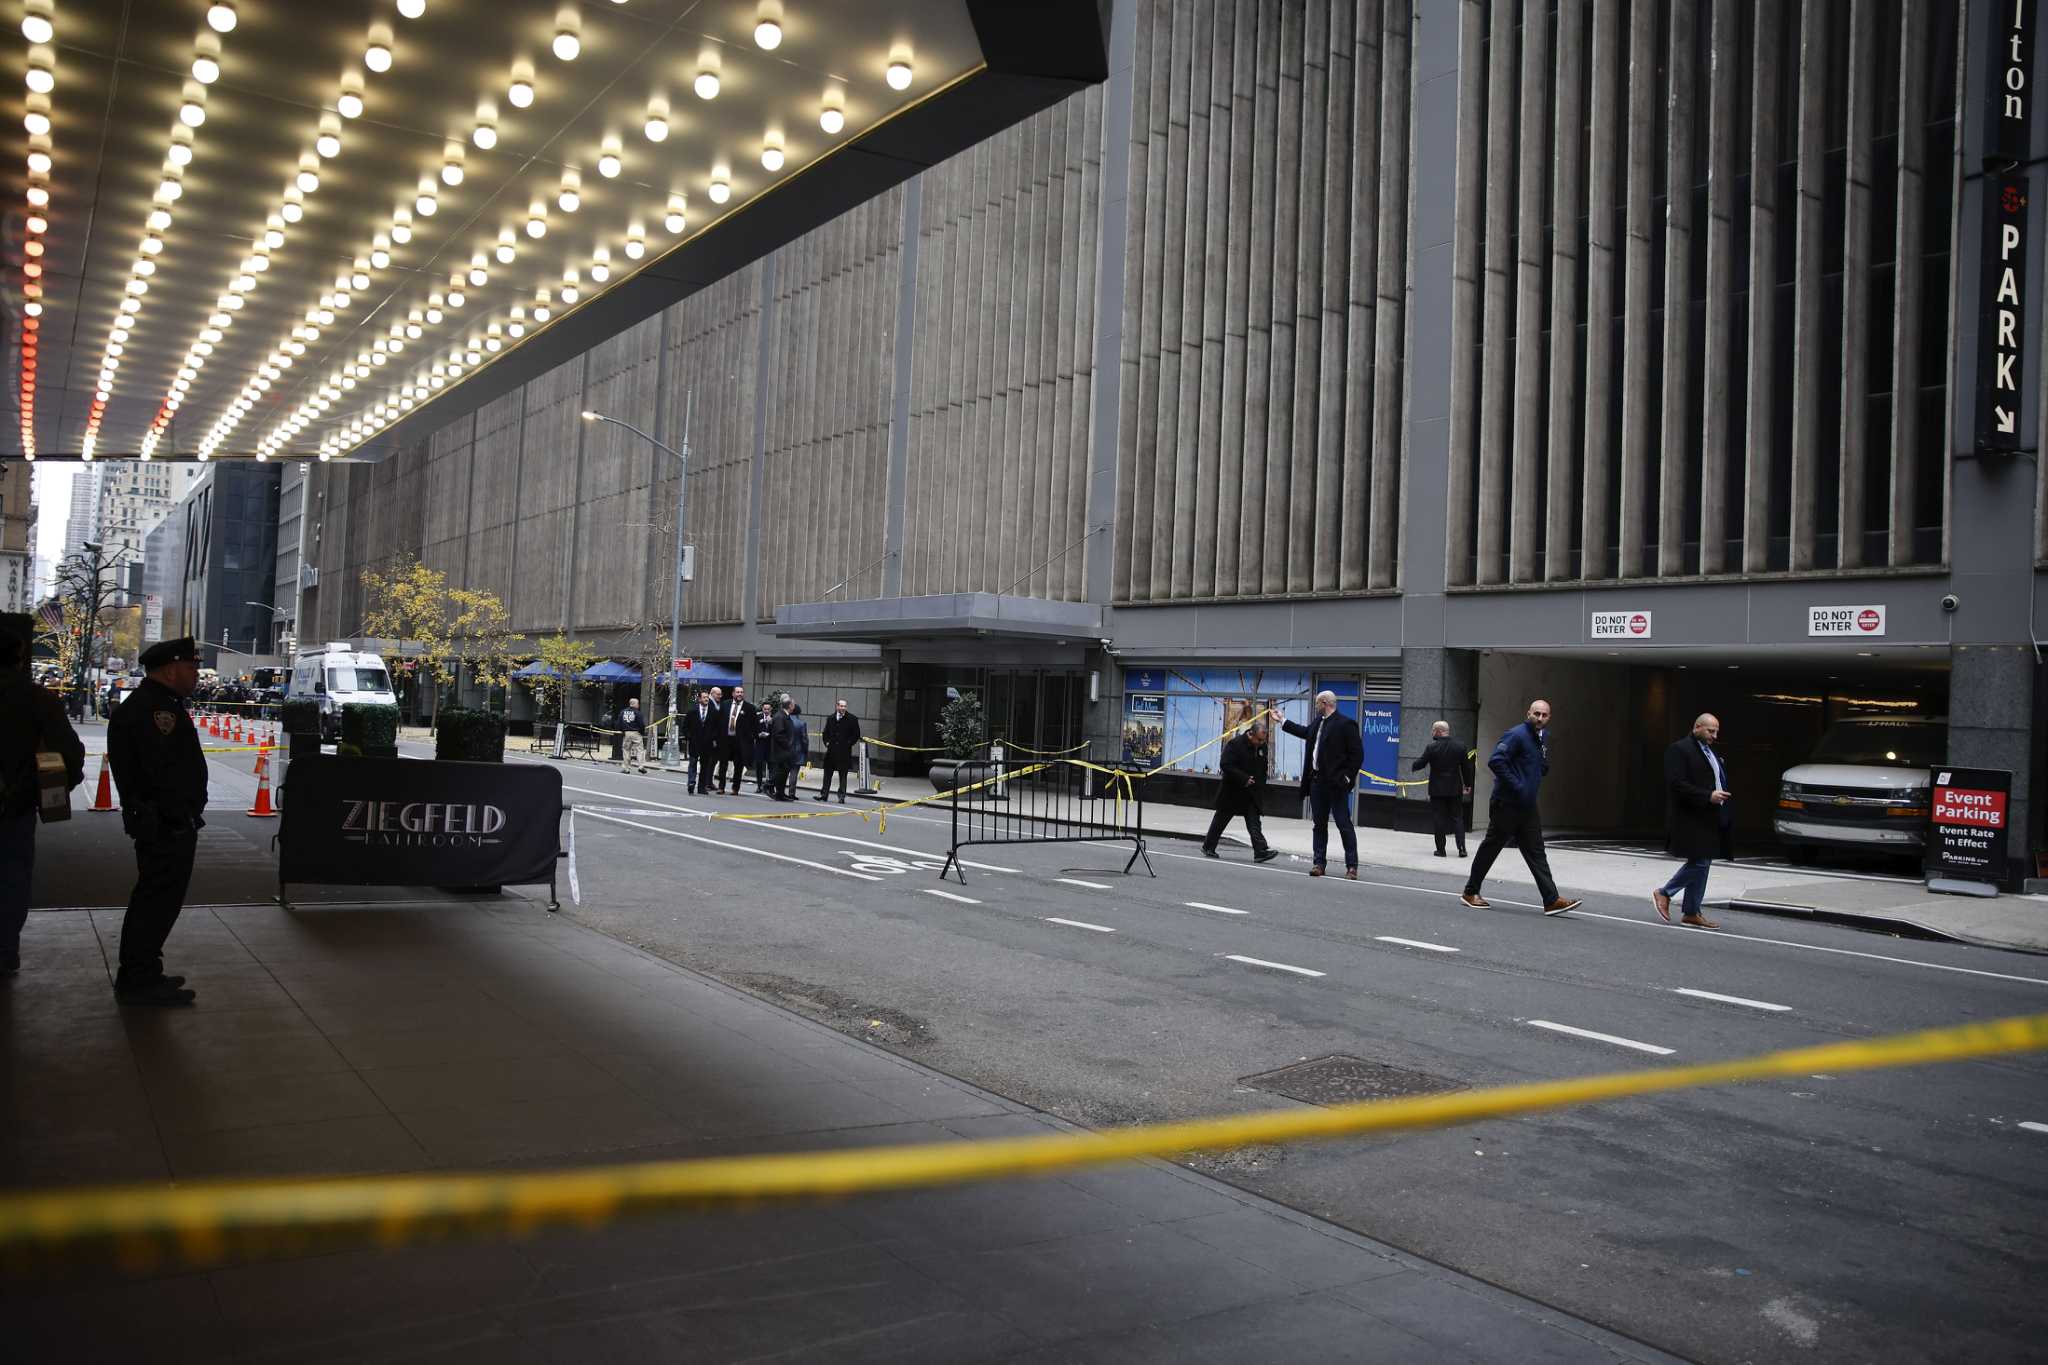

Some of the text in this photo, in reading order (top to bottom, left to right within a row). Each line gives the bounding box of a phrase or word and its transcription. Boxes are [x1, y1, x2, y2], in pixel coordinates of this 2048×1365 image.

[1997, 223, 2020, 391] PARK
[1595, 616, 1607, 624] DO
[1609, 616, 1627, 624] NOT
[1813, 611, 1828, 620] DO
[1831, 611, 1854, 620] NOT
[1596, 625, 1625, 633] ENTER
[1815, 622, 1852, 631] ENTER
[1945, 791, 1992, 806] Event
[342, 800, 506, 834] ZIEGFELD
[1936, 805, 2000, 824] Parking
[1939, 825, 1995, 838] Event Rate
[1945, 838, 1988, 849] In Effect
